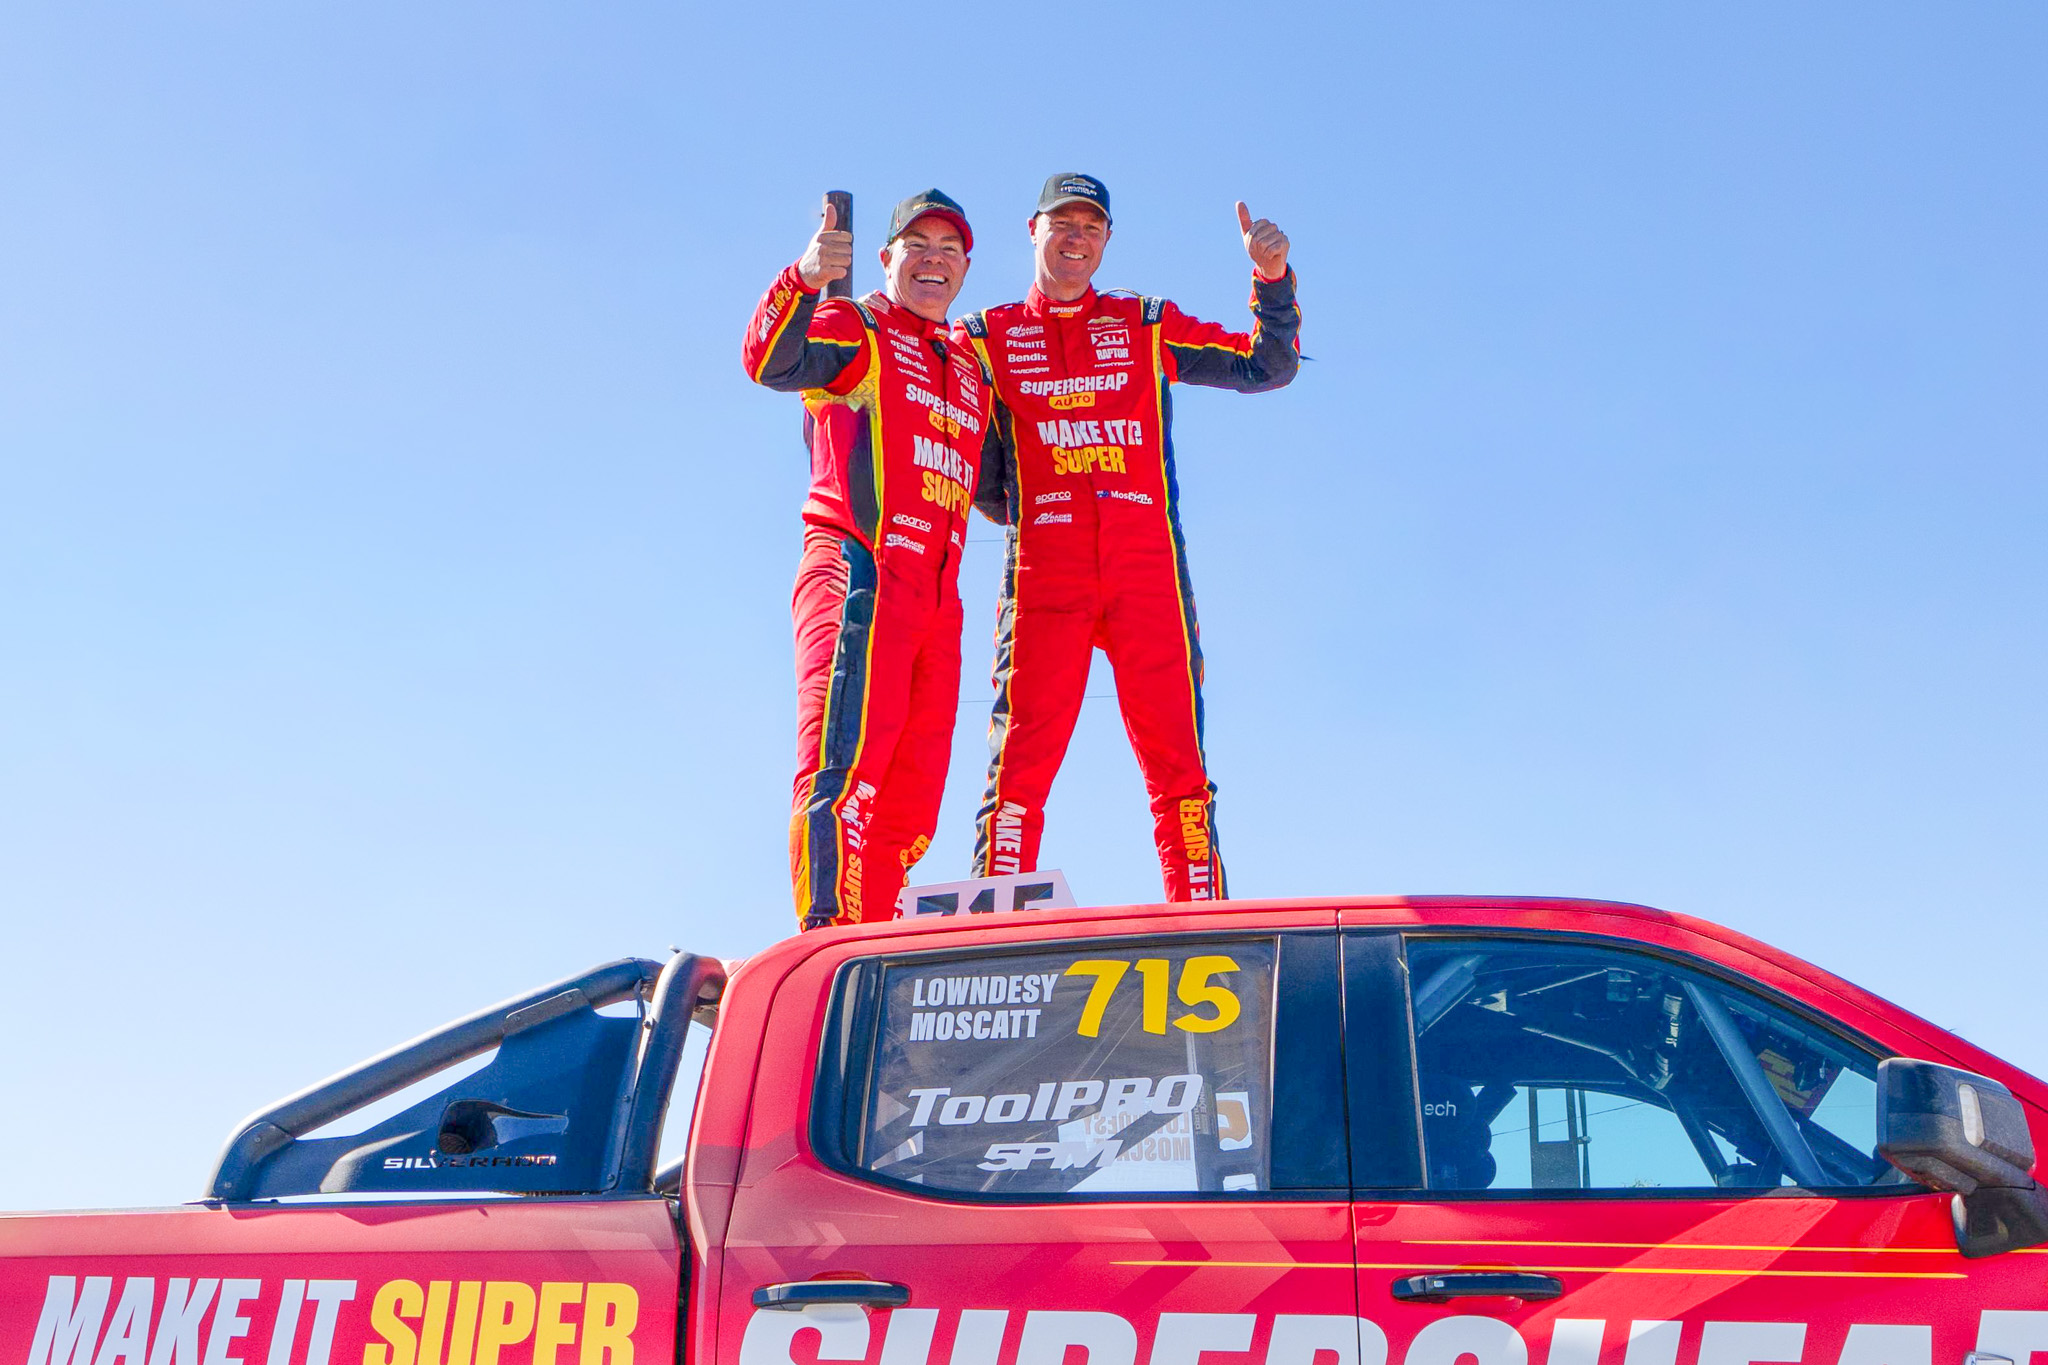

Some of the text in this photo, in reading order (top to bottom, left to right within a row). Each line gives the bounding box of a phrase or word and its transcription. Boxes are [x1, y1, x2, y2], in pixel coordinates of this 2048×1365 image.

[1006, 339, 1047, 349] PENRITE
[1007, 352, 1048, 363] Bendix
[1095, 347, 1129, 361] RAPTOR
[1019, 372, 1129, 397] SUPERCHEAP
[905, 383, 981, 435] SUPERCHEAP
[1054, 395, 1091, 407] AUTO
[1036, 419, 1127, 448] MAKE IT
[913, 434, 962, 485] MAKE
[1051, 446, 1127, 475] SUPER
[921, 470, 971, 524] SUPER
[1035, 491, 1072, 505] sparco
[892, 513, 932, 533] sparco
[994, 800, 1028, 875] MAKE IT
[1179, 798, 1210, 861] SUPER
[844, 852, 863, 924] SUPER
[1188, 863, 1215, 884] IT
[912, 955, 1242, 1038] LOWNDESY 715
[909, 1008, 1042, 1041] MOSCATT
[383, 1155, 557, 1169] SILVERADO
[26, 1275, 262, 1365] MAKE
[265, 1278, 358, 1365] IT
[363, 1278, 640, 1365] SUPER
